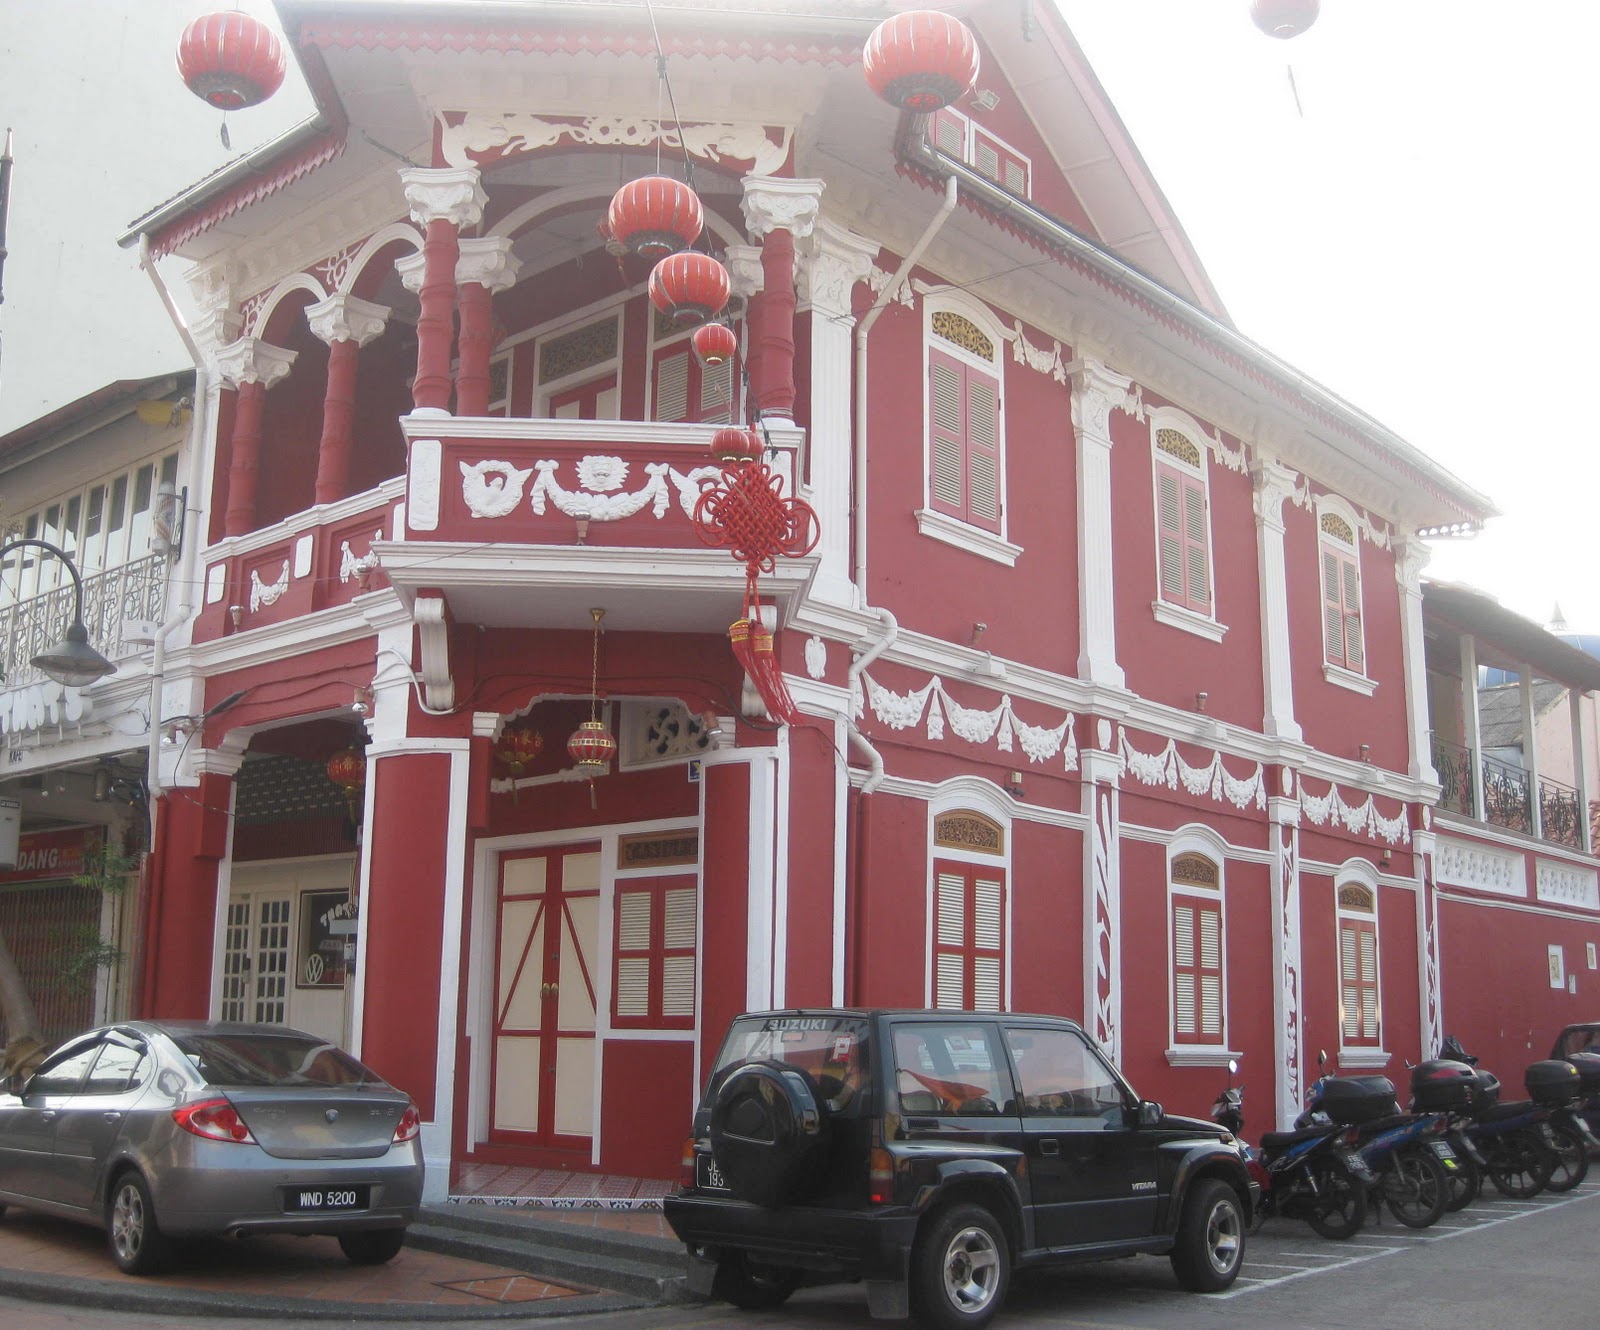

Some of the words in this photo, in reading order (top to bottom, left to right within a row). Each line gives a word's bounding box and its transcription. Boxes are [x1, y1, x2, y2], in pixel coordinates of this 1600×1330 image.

[13, 848, 59, 872] DANG
[769, 1019, 826, 1031] SUZUKI
[832, 1036, 851, 1061] P
[1131, 1181, 1157, 1190] VITARA
[300, 1192, 323, 1207] WND
[326, 1191, 357, 1206] 5200
